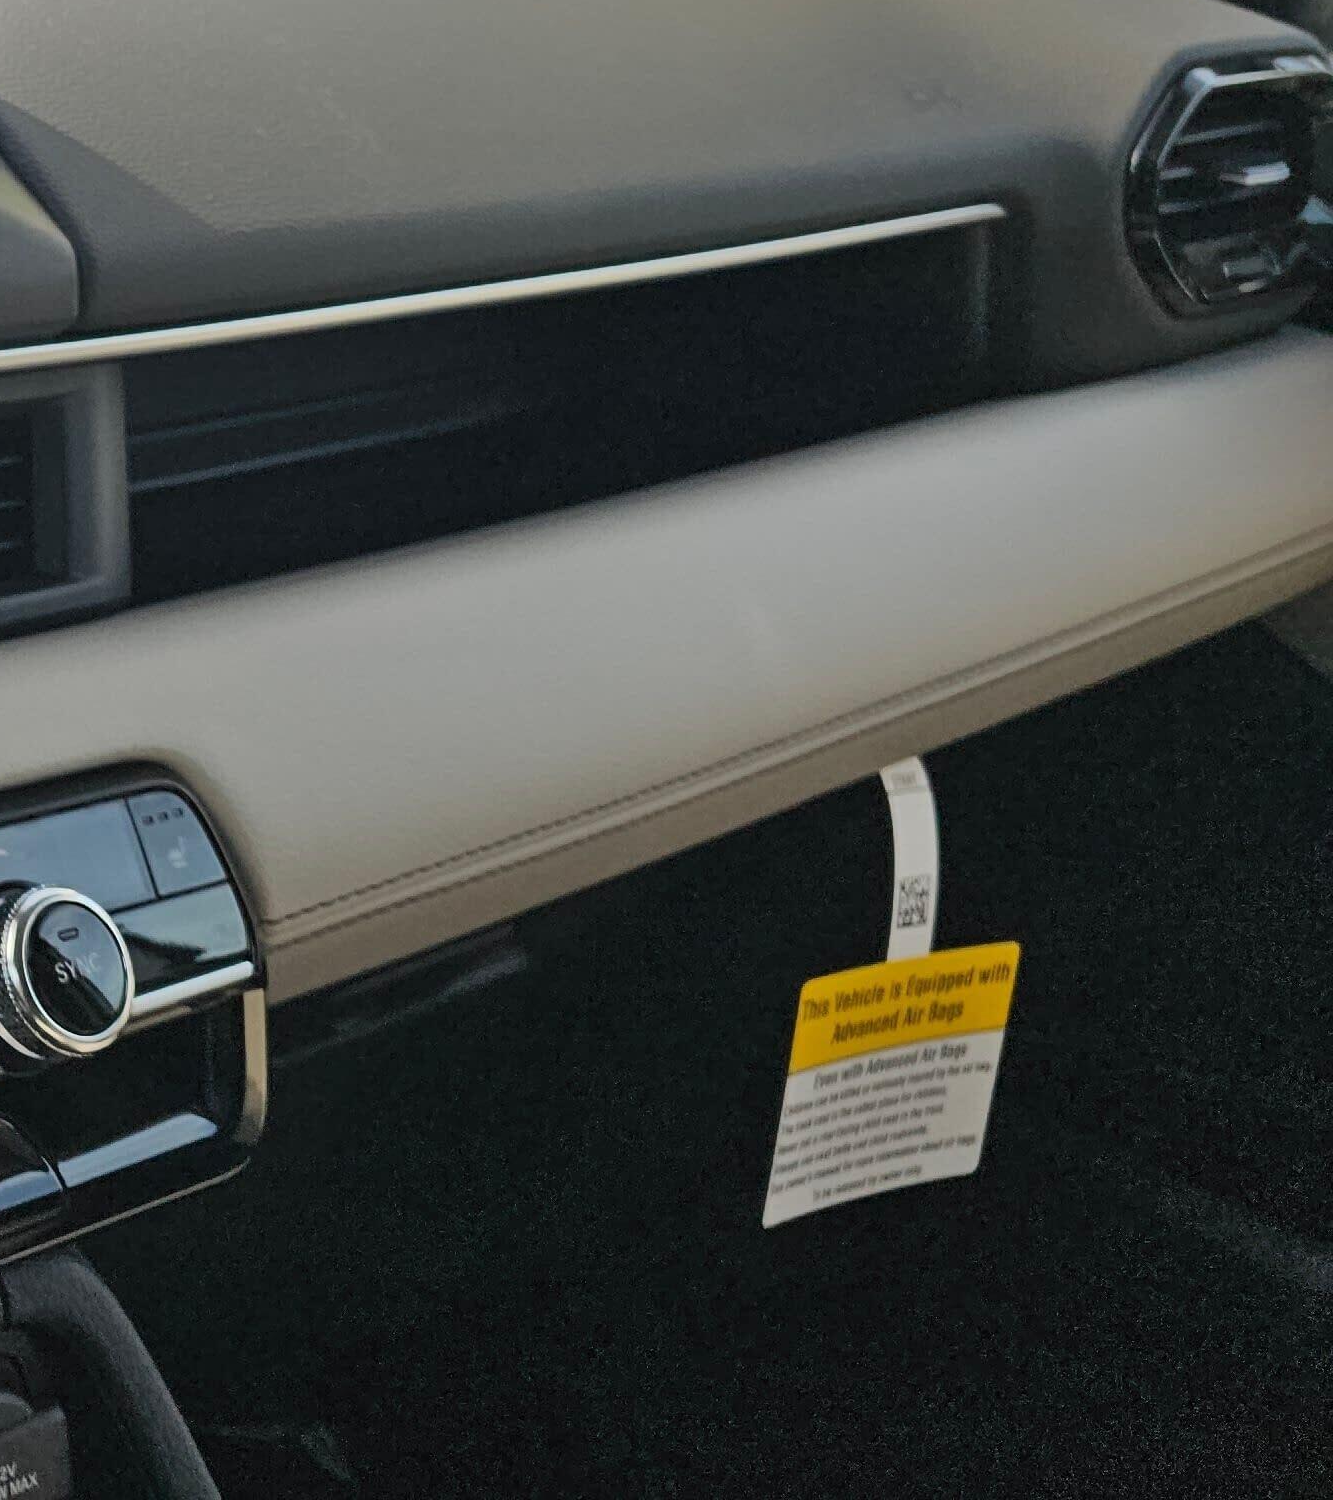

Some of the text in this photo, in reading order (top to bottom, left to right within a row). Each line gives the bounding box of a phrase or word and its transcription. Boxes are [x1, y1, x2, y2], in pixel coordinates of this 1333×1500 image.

[55, 951, 101, 984] SYNC
[801, 999, 831, 1022] This
[834, 984, 886, 1013] Vehicle
[906, 964, 975, 998] Equipped
[979, 961, 1011, 984] with
[831, 998, 965, 1045] Advanced Air Bags
